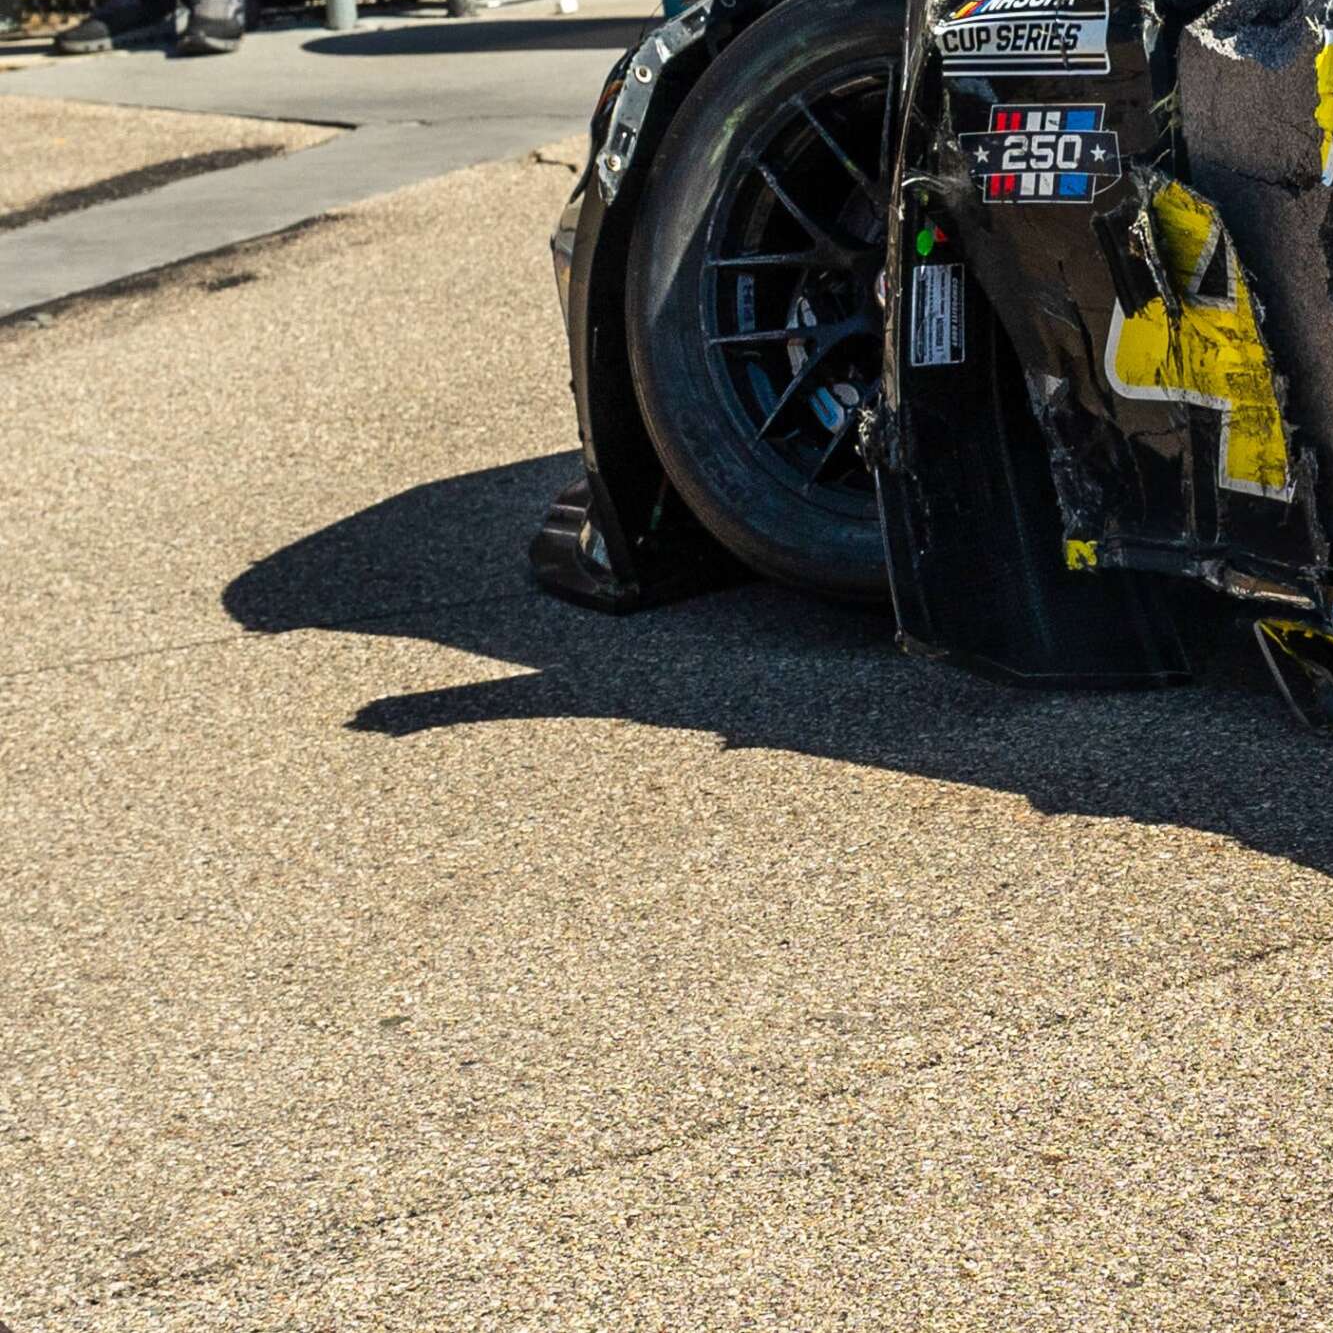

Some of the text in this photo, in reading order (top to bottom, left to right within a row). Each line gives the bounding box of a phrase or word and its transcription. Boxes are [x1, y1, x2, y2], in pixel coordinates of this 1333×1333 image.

[942, 23, 1082, 53] CUP SERIES
[1001, 133, 1083, 170] 250
